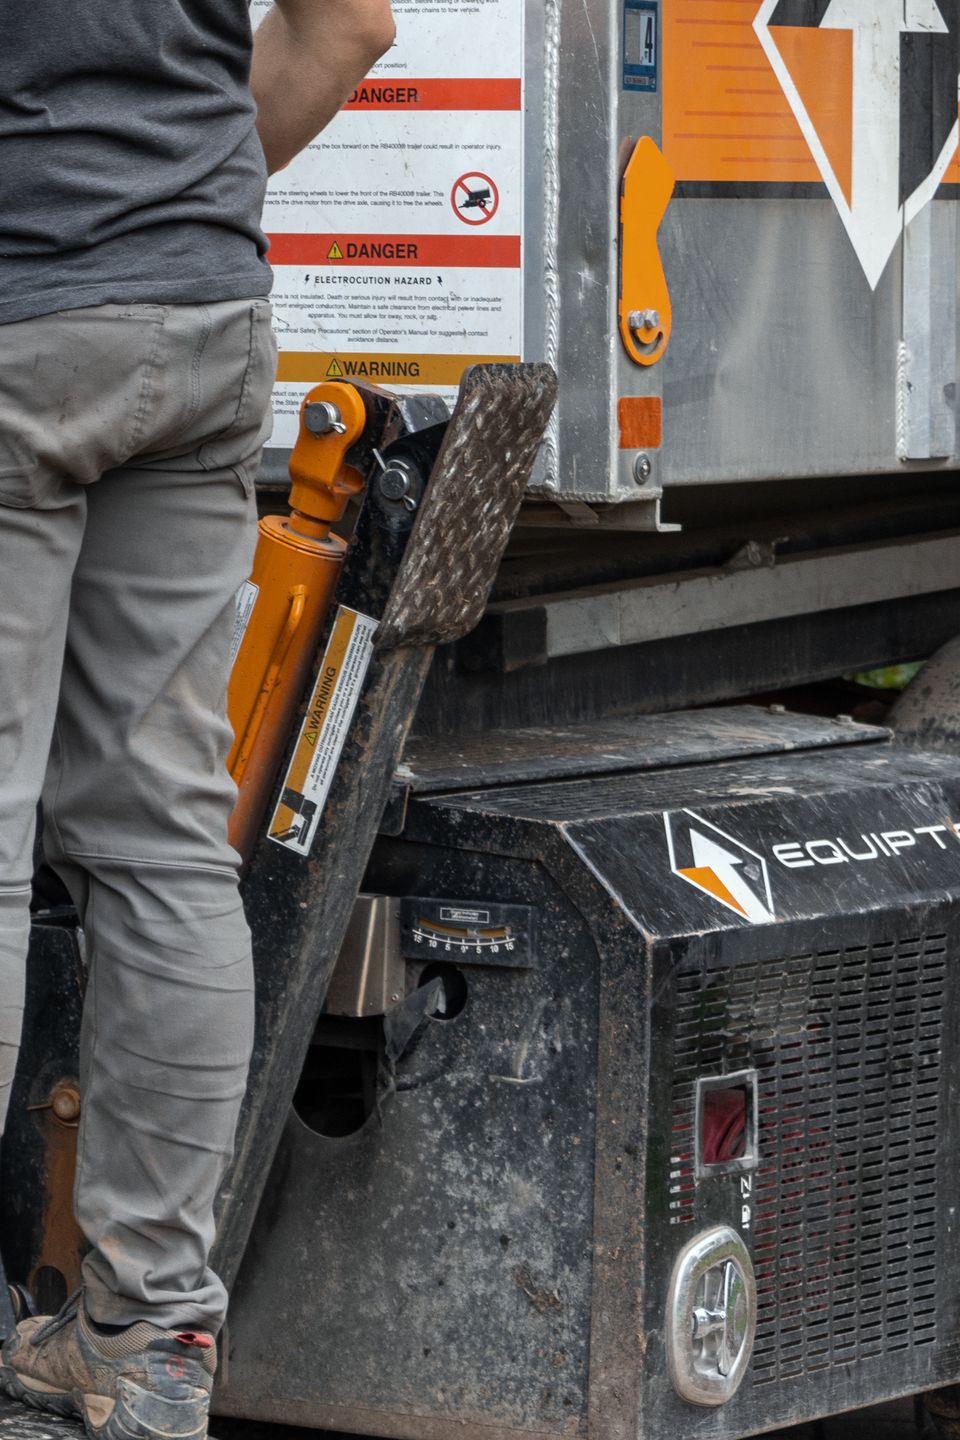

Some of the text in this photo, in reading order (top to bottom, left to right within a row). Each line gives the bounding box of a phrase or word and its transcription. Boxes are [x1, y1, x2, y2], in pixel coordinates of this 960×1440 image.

[645, 17, 653, 63] 4
[346, 243, 417, 258] DANGER
[315, 276, 432, 285] ELECTROCUTION HAZARD
[344, 361, 420, 376] WARNING
[309, 665, 336, 729] WARNING
[772, 822, 960, 868] EQUIPT
[413, 934, 423, 943] 15
[429, 940, 437, 948] 10
[476, 946, 482, 954] 5
[490, 945, 499, 953] 10
[505, 943, 514, 951] 15
